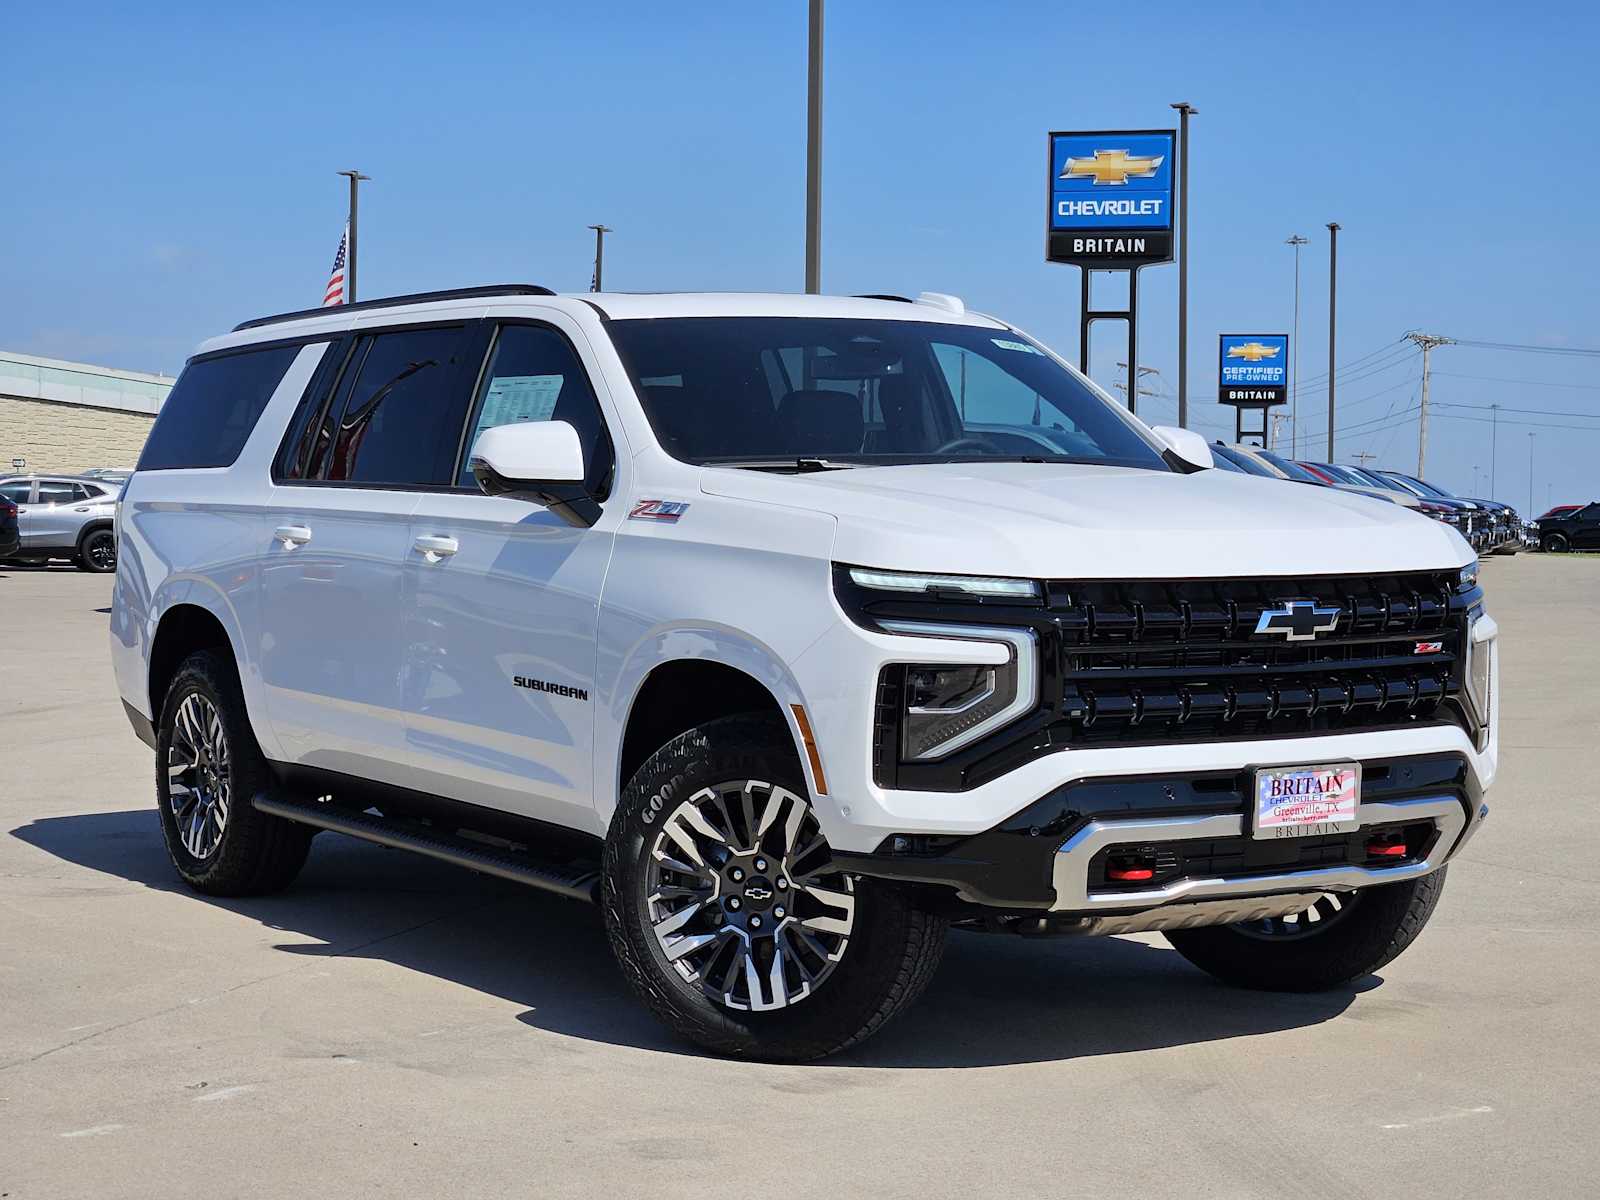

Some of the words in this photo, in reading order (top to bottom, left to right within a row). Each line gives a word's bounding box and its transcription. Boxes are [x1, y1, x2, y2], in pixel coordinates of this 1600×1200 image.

[1057, 199, 1163, 216] CHEVROLET
[1073, 238, 1146, 253] BRITAIN
[1223, 367, 1283, 375] CERTIFIED
[1229, 391, 1276, 400] BRITAIN
[513, 675, 588, 701] SUBURBAN
[1271, 775, 1344, 796] BRITAIN
[1270, 794, 1323, 804] CHEVROLET
[1273, 804, 1323, 817] Greenville,
[1325, 802, 1340, 813] TX
[1275, 822, 1341, 838] BRITAIN
